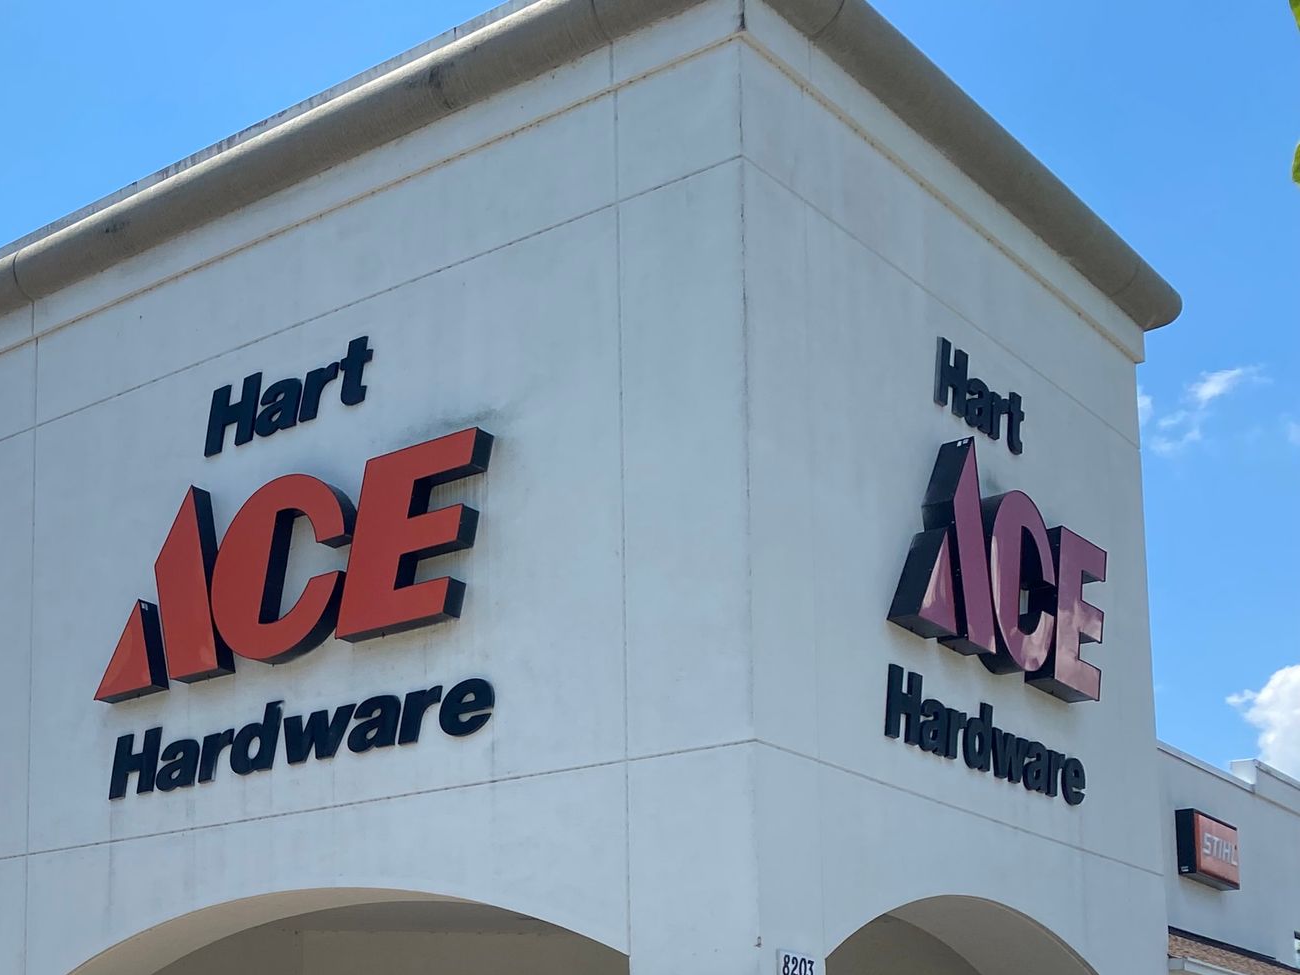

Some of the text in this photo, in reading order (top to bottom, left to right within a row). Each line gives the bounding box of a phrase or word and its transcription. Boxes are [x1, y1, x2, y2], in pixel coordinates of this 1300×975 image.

[204, 335, 374, 457] Hart
[933, 335, 1024, 455] Hart
[93, 426, 495, 704] ACE
[886, 435, 1108, 703] ACE
[108, 677, 496, 801] Hardware
[884, 662, 1086, 806] Hardware
[1203, 831, 1239, 867] STIHL
